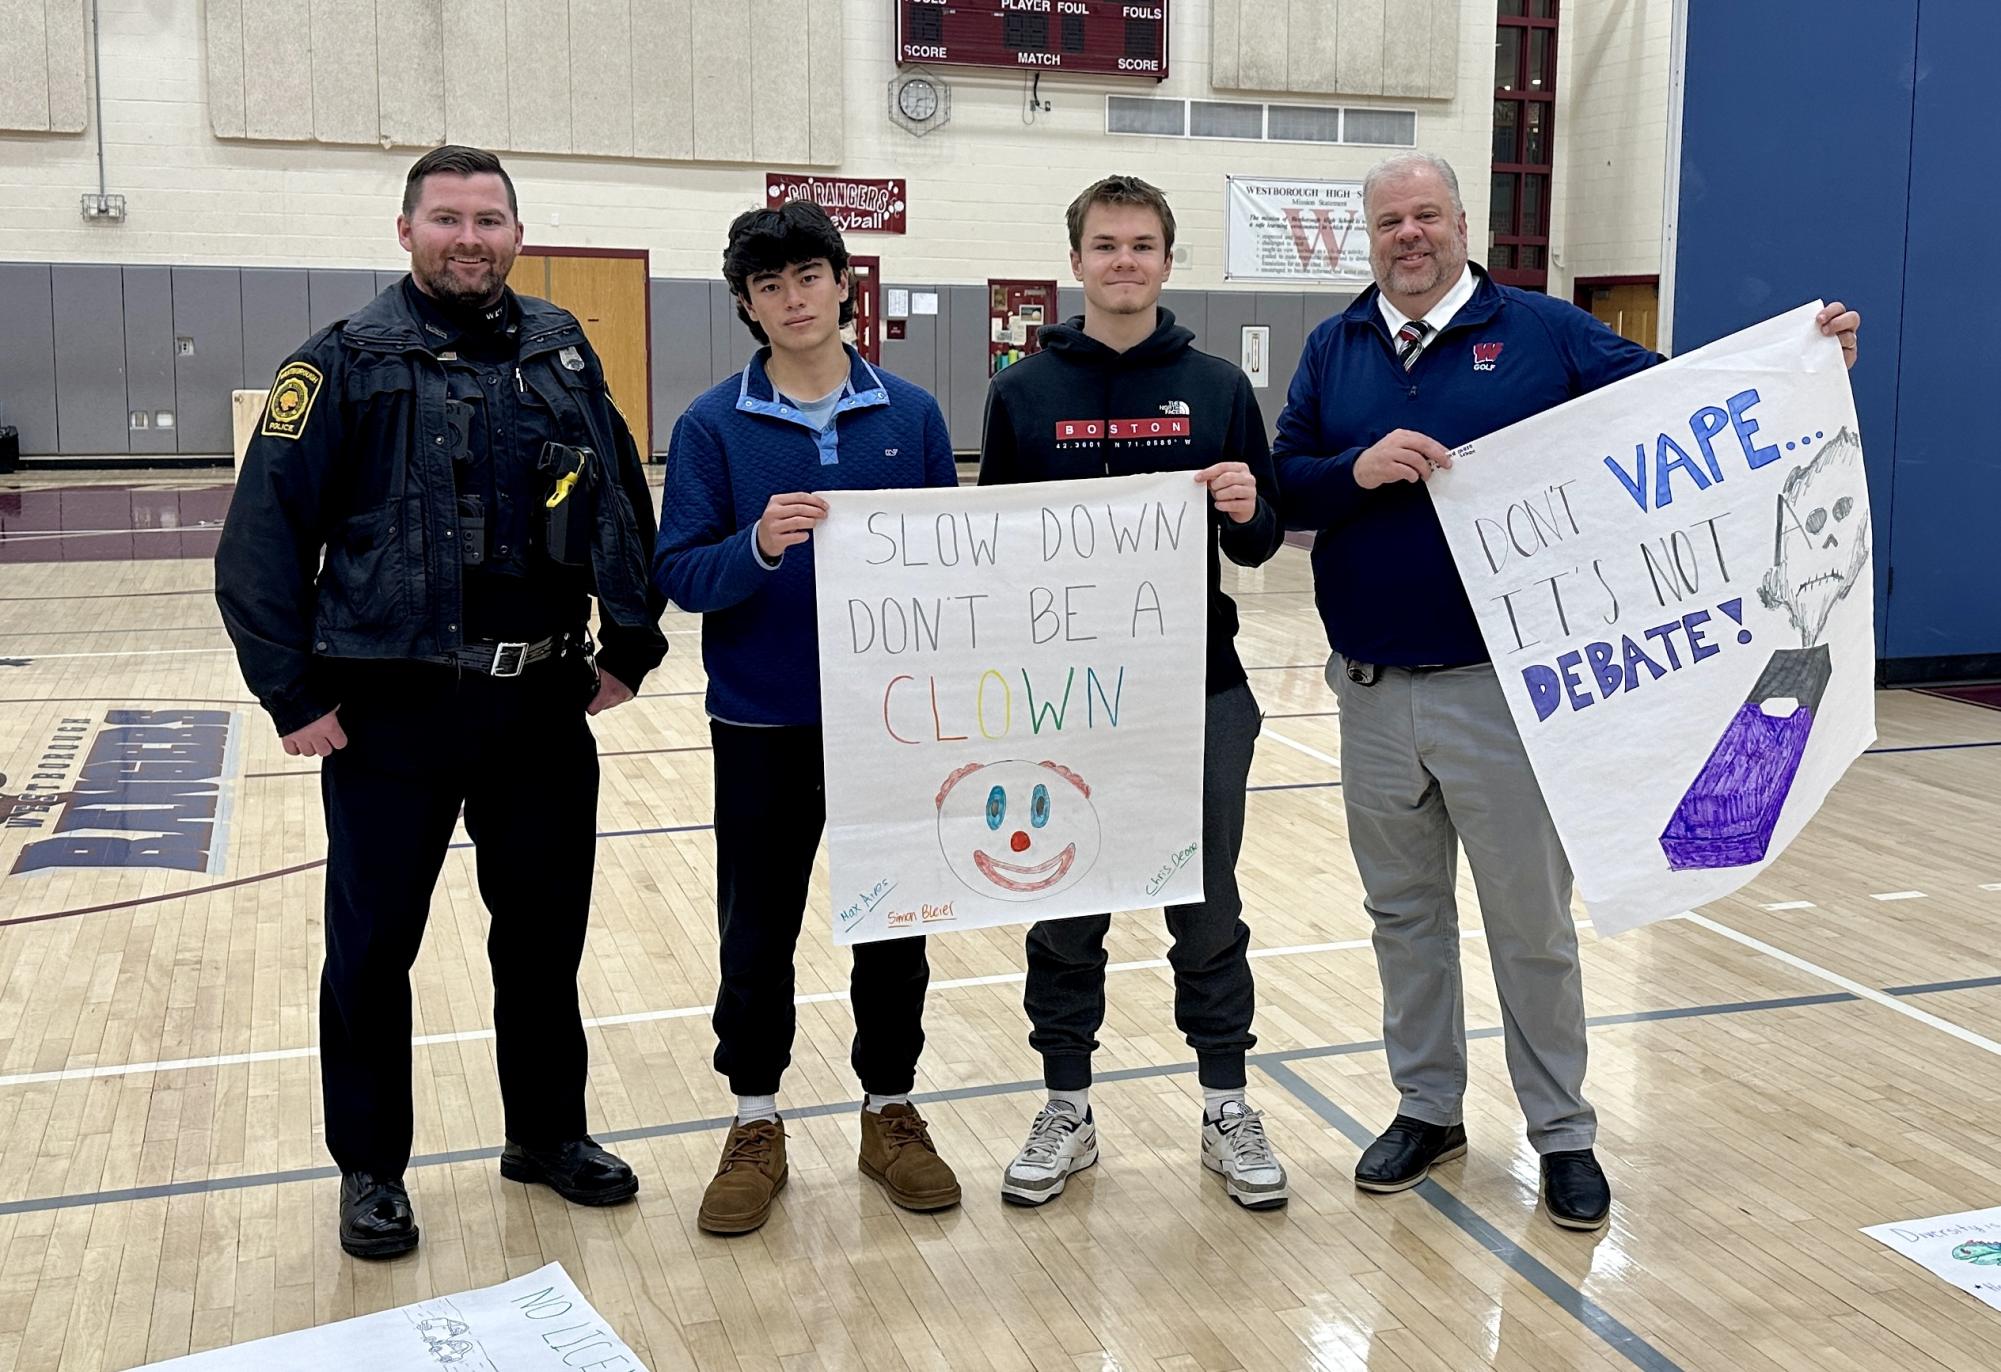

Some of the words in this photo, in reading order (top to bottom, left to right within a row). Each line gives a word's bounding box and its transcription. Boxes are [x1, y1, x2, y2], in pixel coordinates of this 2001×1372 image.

[1001, 0, 1050, 12] PLAYER
[1058, 2, 1089, 15] FOUL
[1123, 6, 1162, 19] FOULS
[904, 44, 947, 58] SCORE
[1017, 52, 1061, 65] MATCH
[1118, 58, 1159, 71] SCORE
[813, 182, 889, 213] RANGERS
[1246, 186, 1319, 198] WESTBOROUGH
[1326, 189, 1351, 198] HIGH
[830, 212, 882, 231] eyball
[269, 422, 295, 432] POLICE
[1065, 422, 1181, 435] BOSTON
[866, 511, 999, 567] SLOW
[1042, 501, 1187, 562] DOWN
[1475, 478, 1580, 575] DON'T
[1490, 559, 1619, 655] IT'S
[1640, 511, 1732, 607] NOT
[848, 593, 989, 655] DON'T
[1029, 584, 1098, 645] BE
[1132, 580, 1165, 638] A
[1521, 597, 1753, 723] DEBATE!
[883, 665, 1124, 745] CLOWN
[1145, 865, 1172, 895] Chris
[839, 902, 863, 922] Max
[887, 910, 918, 925] Simon
[511, 1286, 573, 1320] NO
[541, 1321, 637, 1372] LICE
